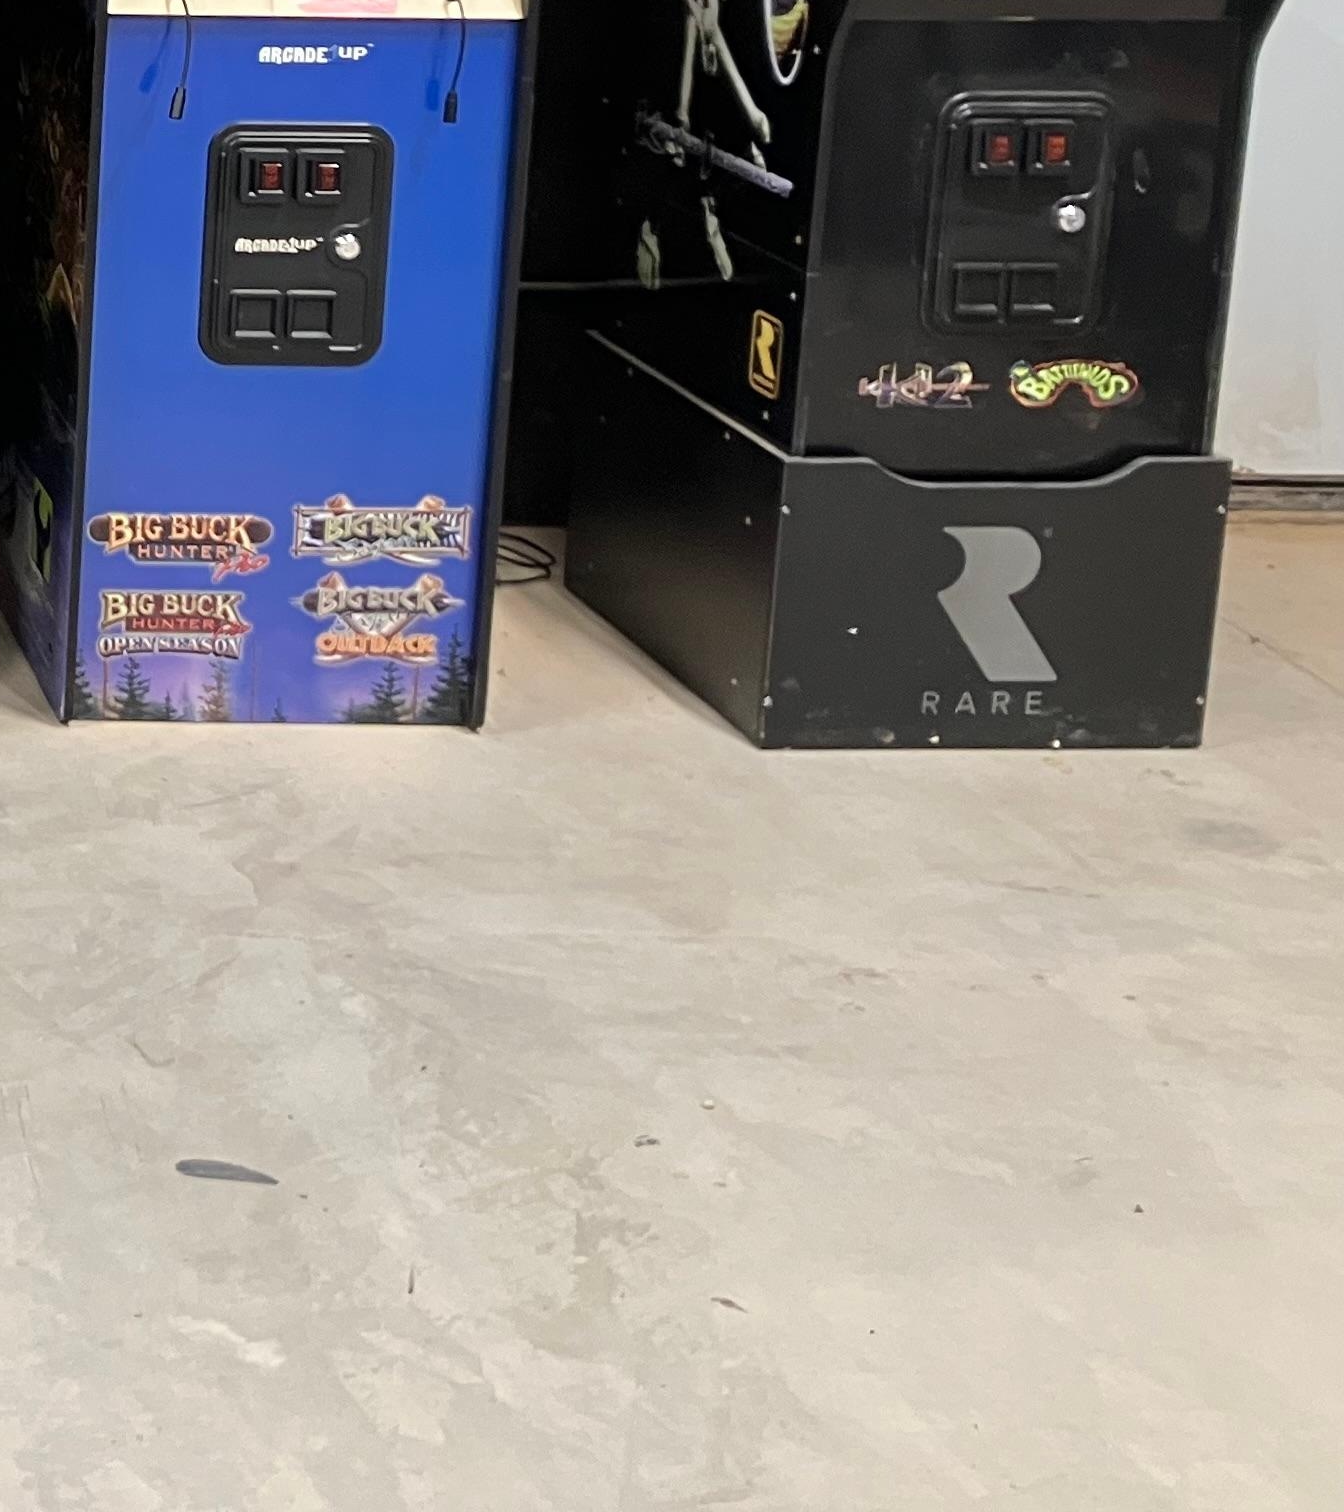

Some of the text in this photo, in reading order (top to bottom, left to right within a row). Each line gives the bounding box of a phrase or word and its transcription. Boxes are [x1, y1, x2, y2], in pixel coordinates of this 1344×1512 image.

[106, 513, 257, 555] BIG BUCK
[324, 513, 441, 546] BIG BUCK
[137, 544, 229, 560] HUNTER
[101, 592, 245, 630] BIG BUCK
[318, 588, 440, 617] BIG BUCK
[131, 617, 216, 630] HUNTER
[98, 637, 240, 660] OPEN SEASON
[316, 633, 437, 655] OUTBACK
[920, 689, 1045, 716] RARE
